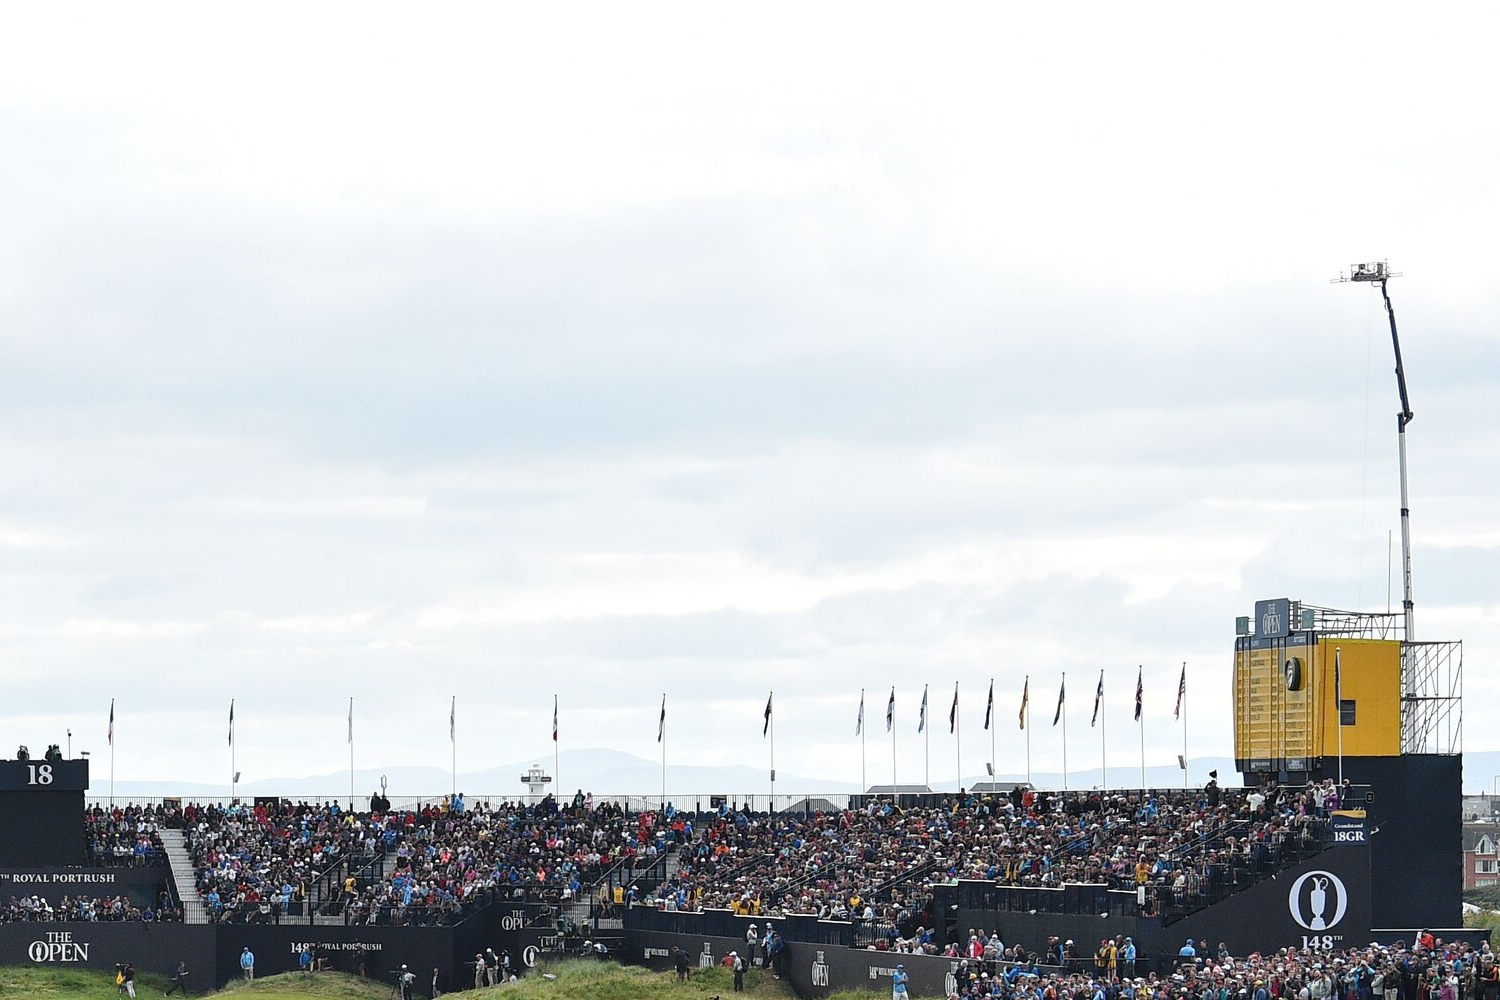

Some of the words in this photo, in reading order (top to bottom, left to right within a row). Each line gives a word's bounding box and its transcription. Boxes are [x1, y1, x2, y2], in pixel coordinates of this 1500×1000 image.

[27, 764, 53, 785] 18
[1334, 831, 1365, 842] 18GR
[12, 874, 49, 883] ROYAL
[52, 874, 115, 883] PORTRUSH
[46, 931, 73, 943] THE
[1301, 935, 1343, 950] 148TH
[28, 940, 90, 962] OPEN
[811, 960, 829, 987] OPEN
